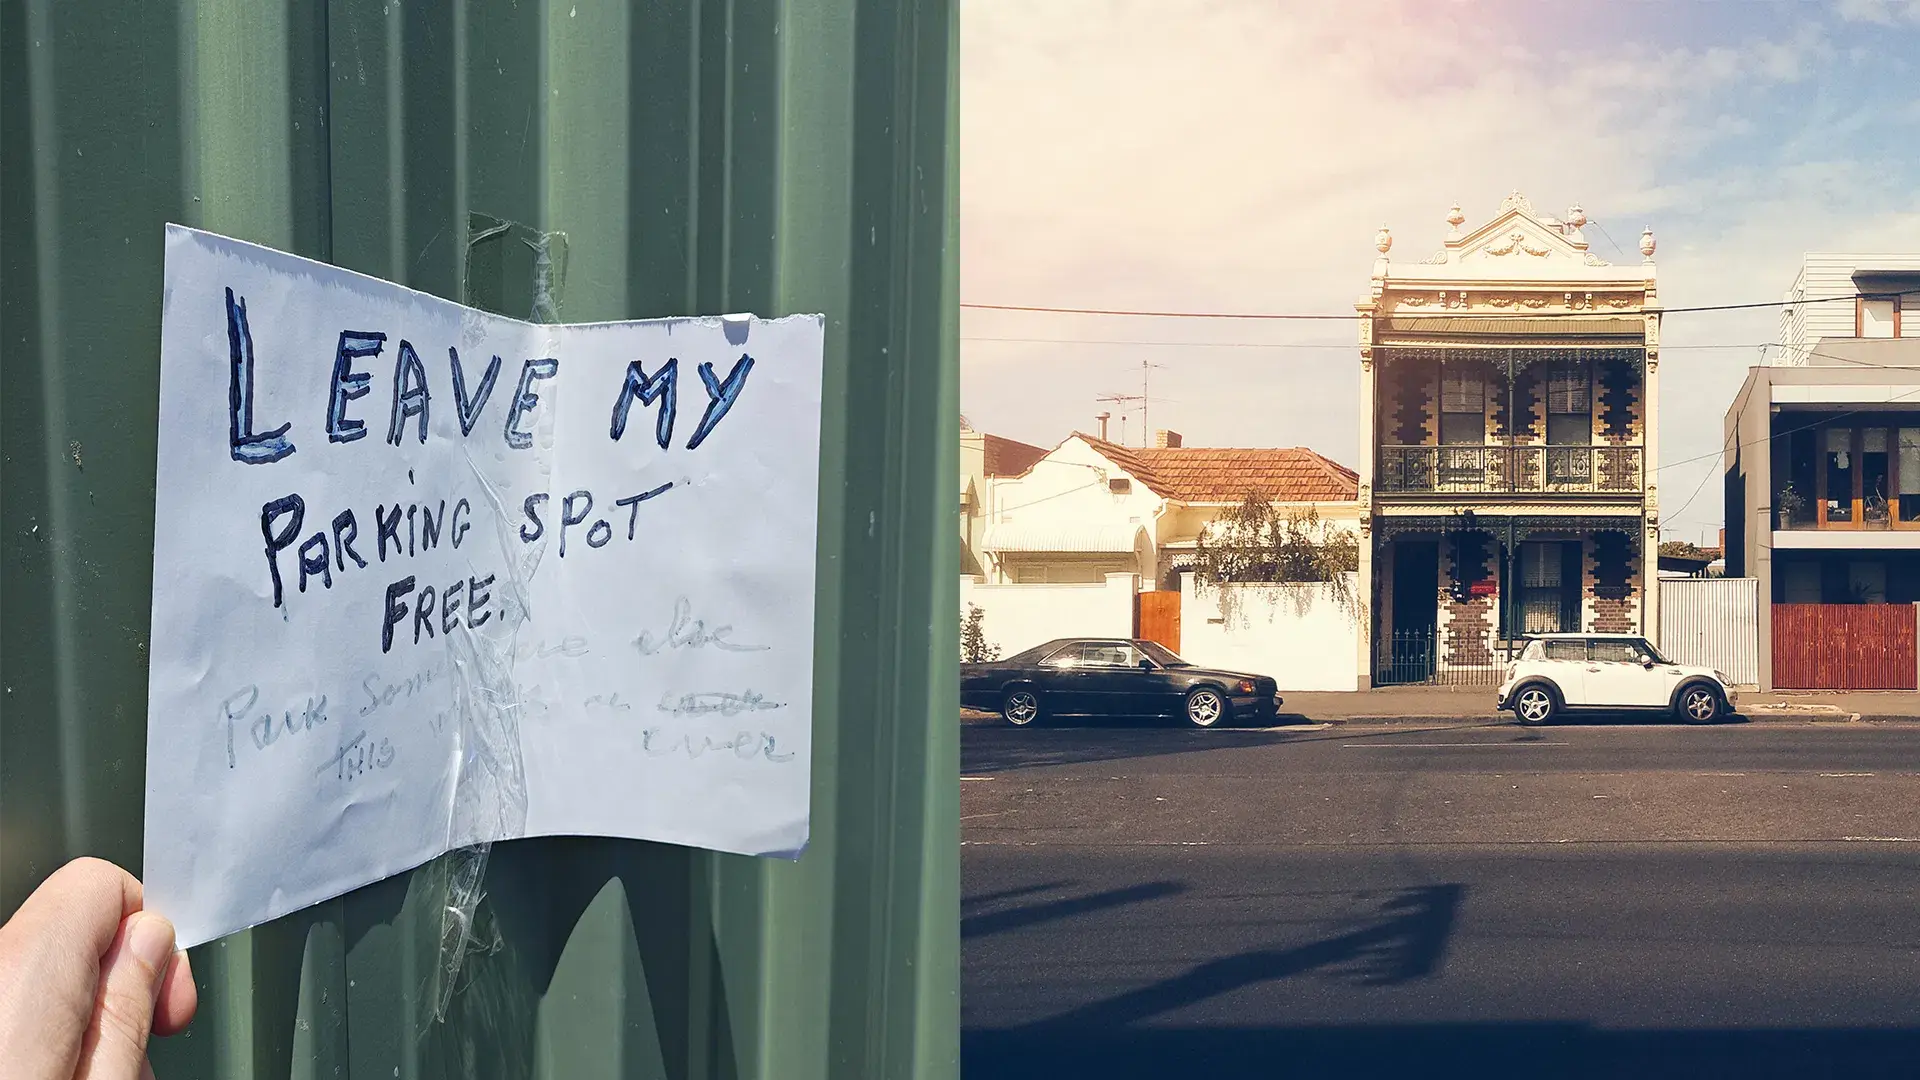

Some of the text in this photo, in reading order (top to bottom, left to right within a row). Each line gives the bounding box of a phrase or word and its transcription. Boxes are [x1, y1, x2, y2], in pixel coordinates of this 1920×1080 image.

[225, 286, 755, 465] LEAVE MY
[261, 467, 692, 608] PARKING SPOT
[382, 574, 506, 654] FREE.
